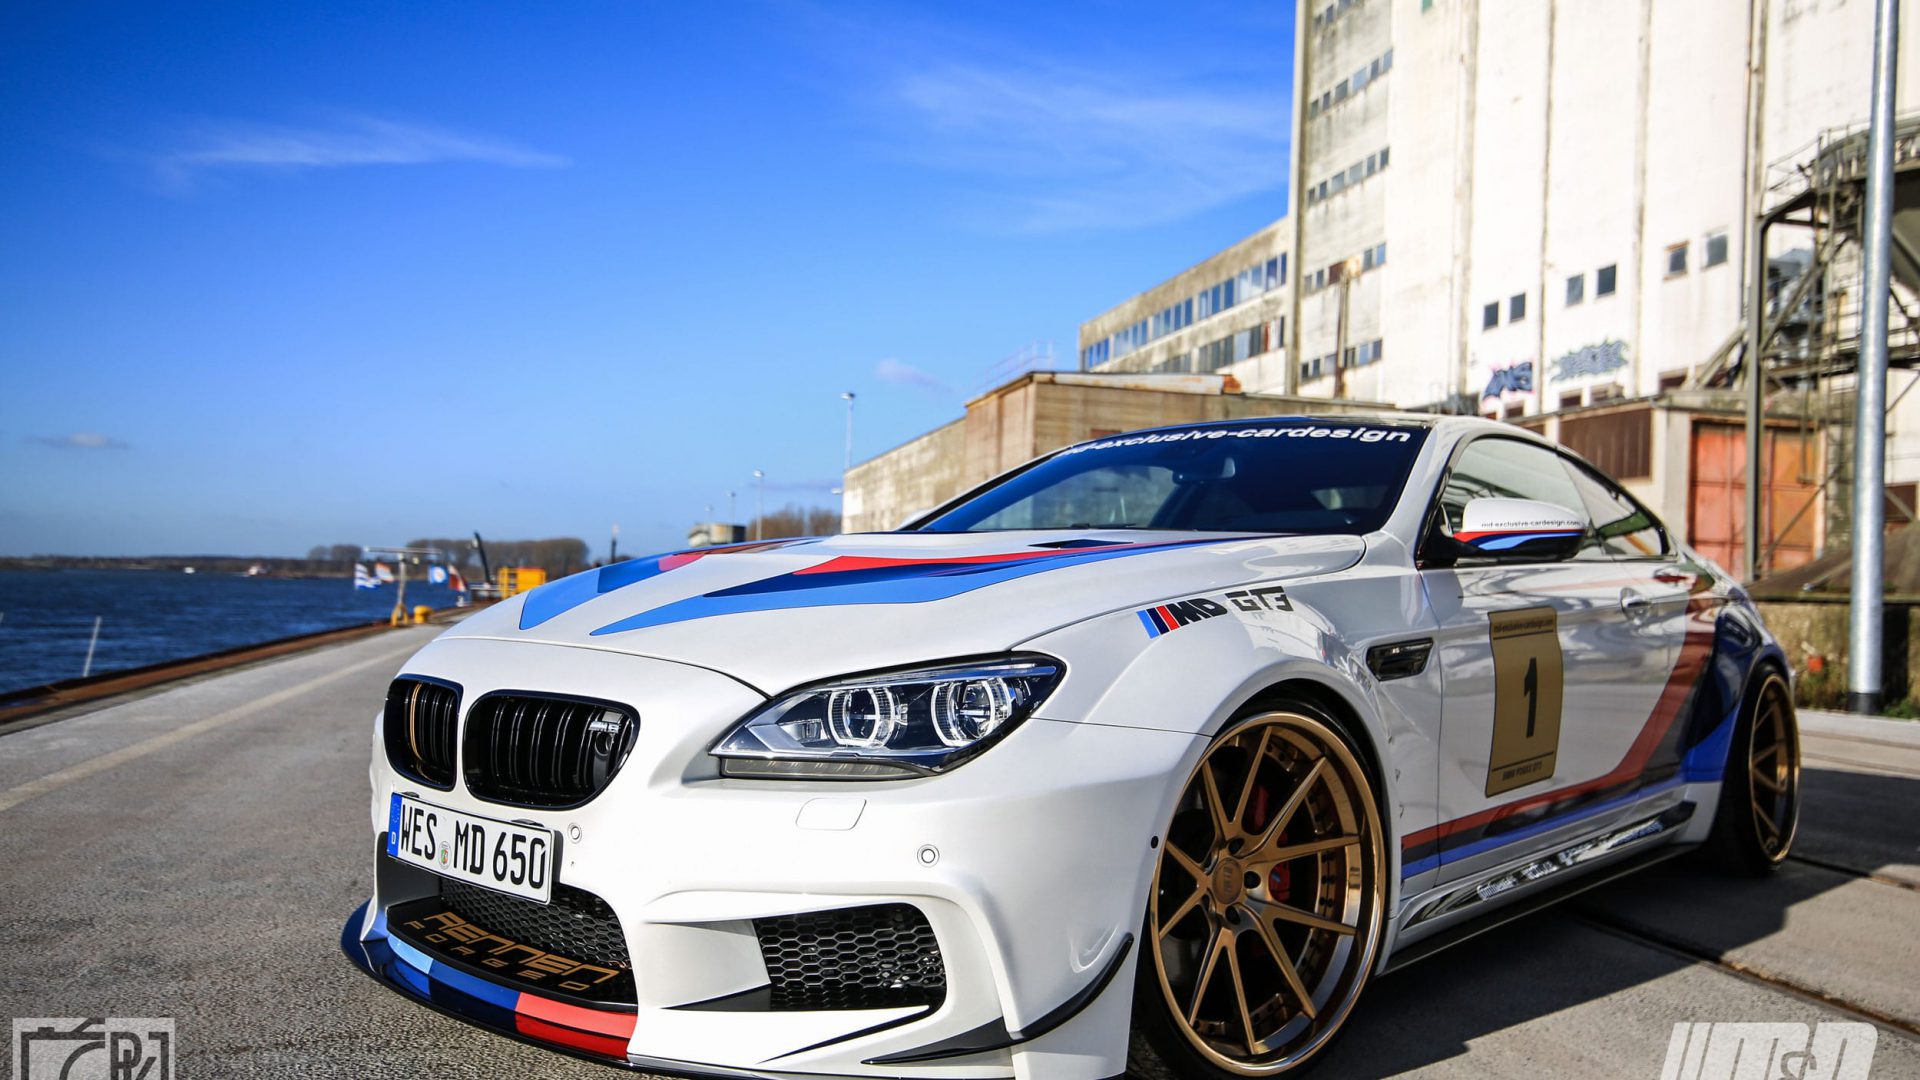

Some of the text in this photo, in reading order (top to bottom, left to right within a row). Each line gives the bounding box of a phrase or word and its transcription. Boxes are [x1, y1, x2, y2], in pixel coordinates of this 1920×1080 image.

[1225, 586, 1294, 612] GT3
[1524, 657, 1538, 739] 1
[401, 804, 438, 860] WES
[453, 820, 486, 875] MD
[492, 831, 546, 889] 650
